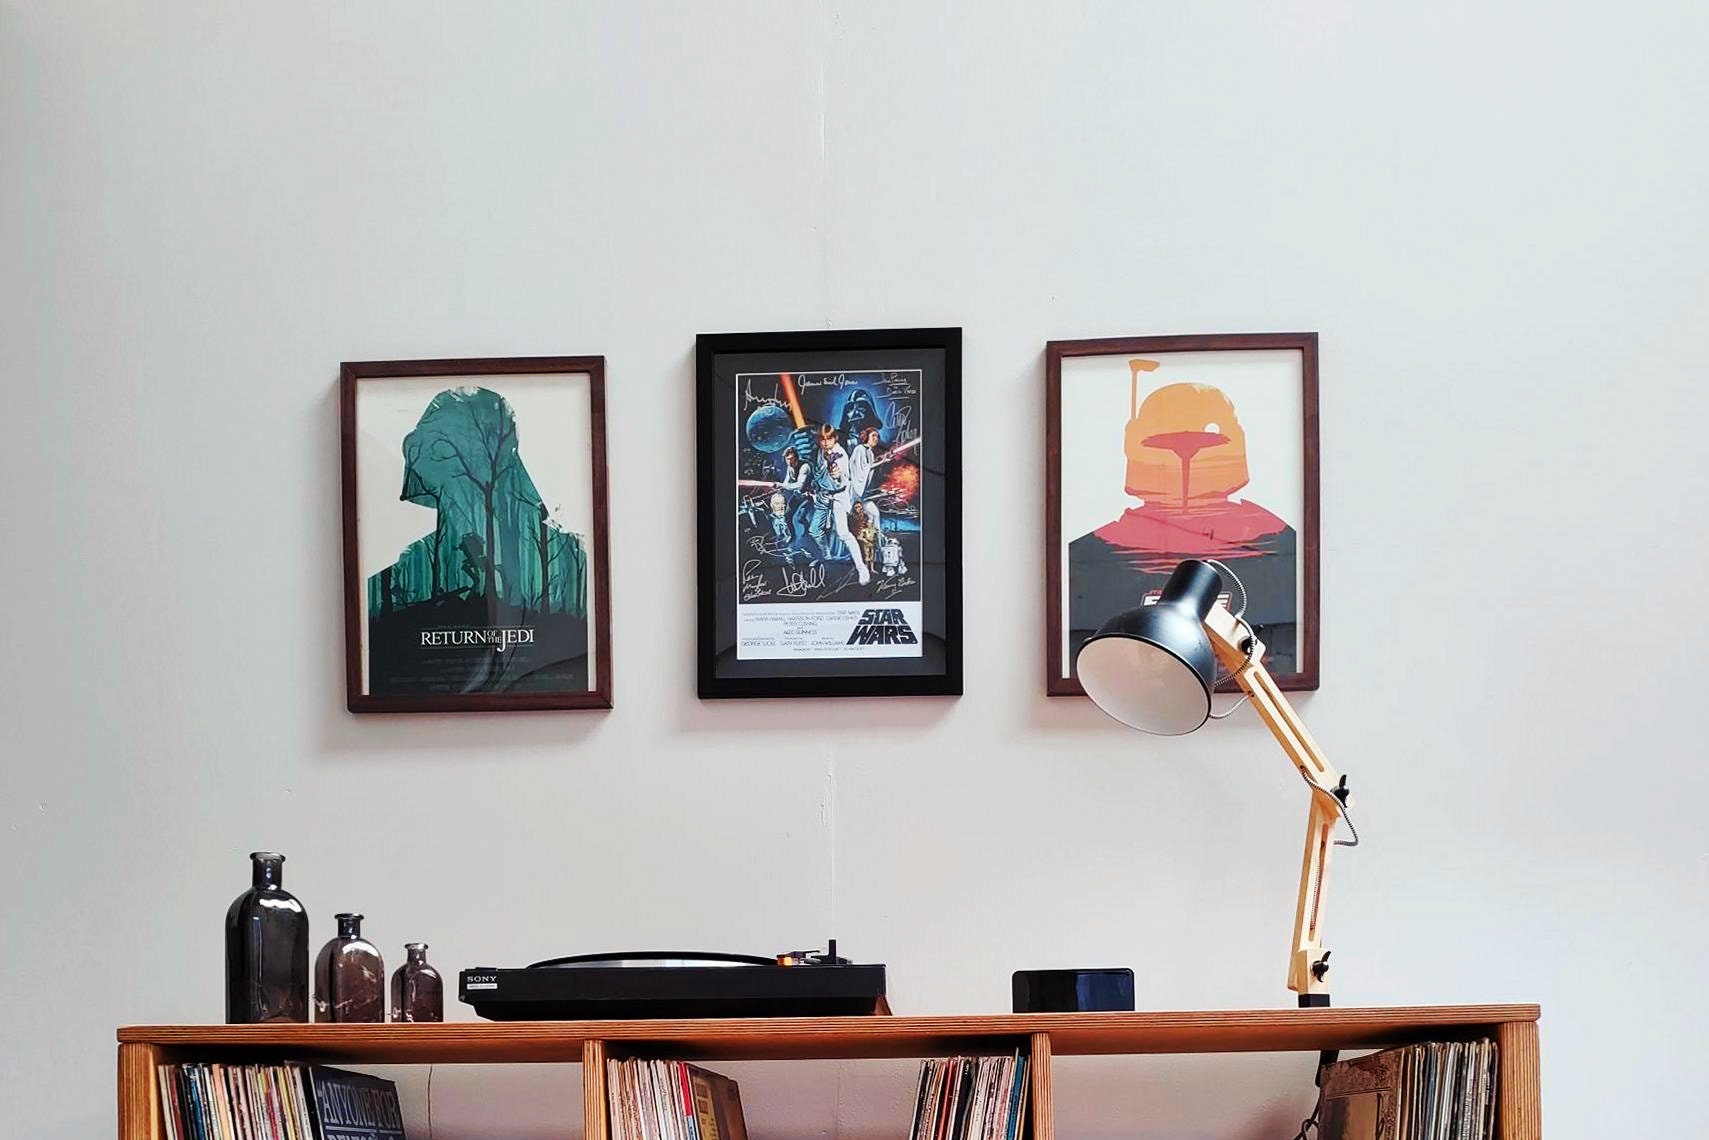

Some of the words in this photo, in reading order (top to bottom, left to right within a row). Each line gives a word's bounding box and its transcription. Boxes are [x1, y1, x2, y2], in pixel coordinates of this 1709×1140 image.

[858, 609, 908, 625] STAR
[421, 630, 487, 645] RETURN
[497, 629, 535, 652] JEDI
[846, 625, 918, 645] WARS
